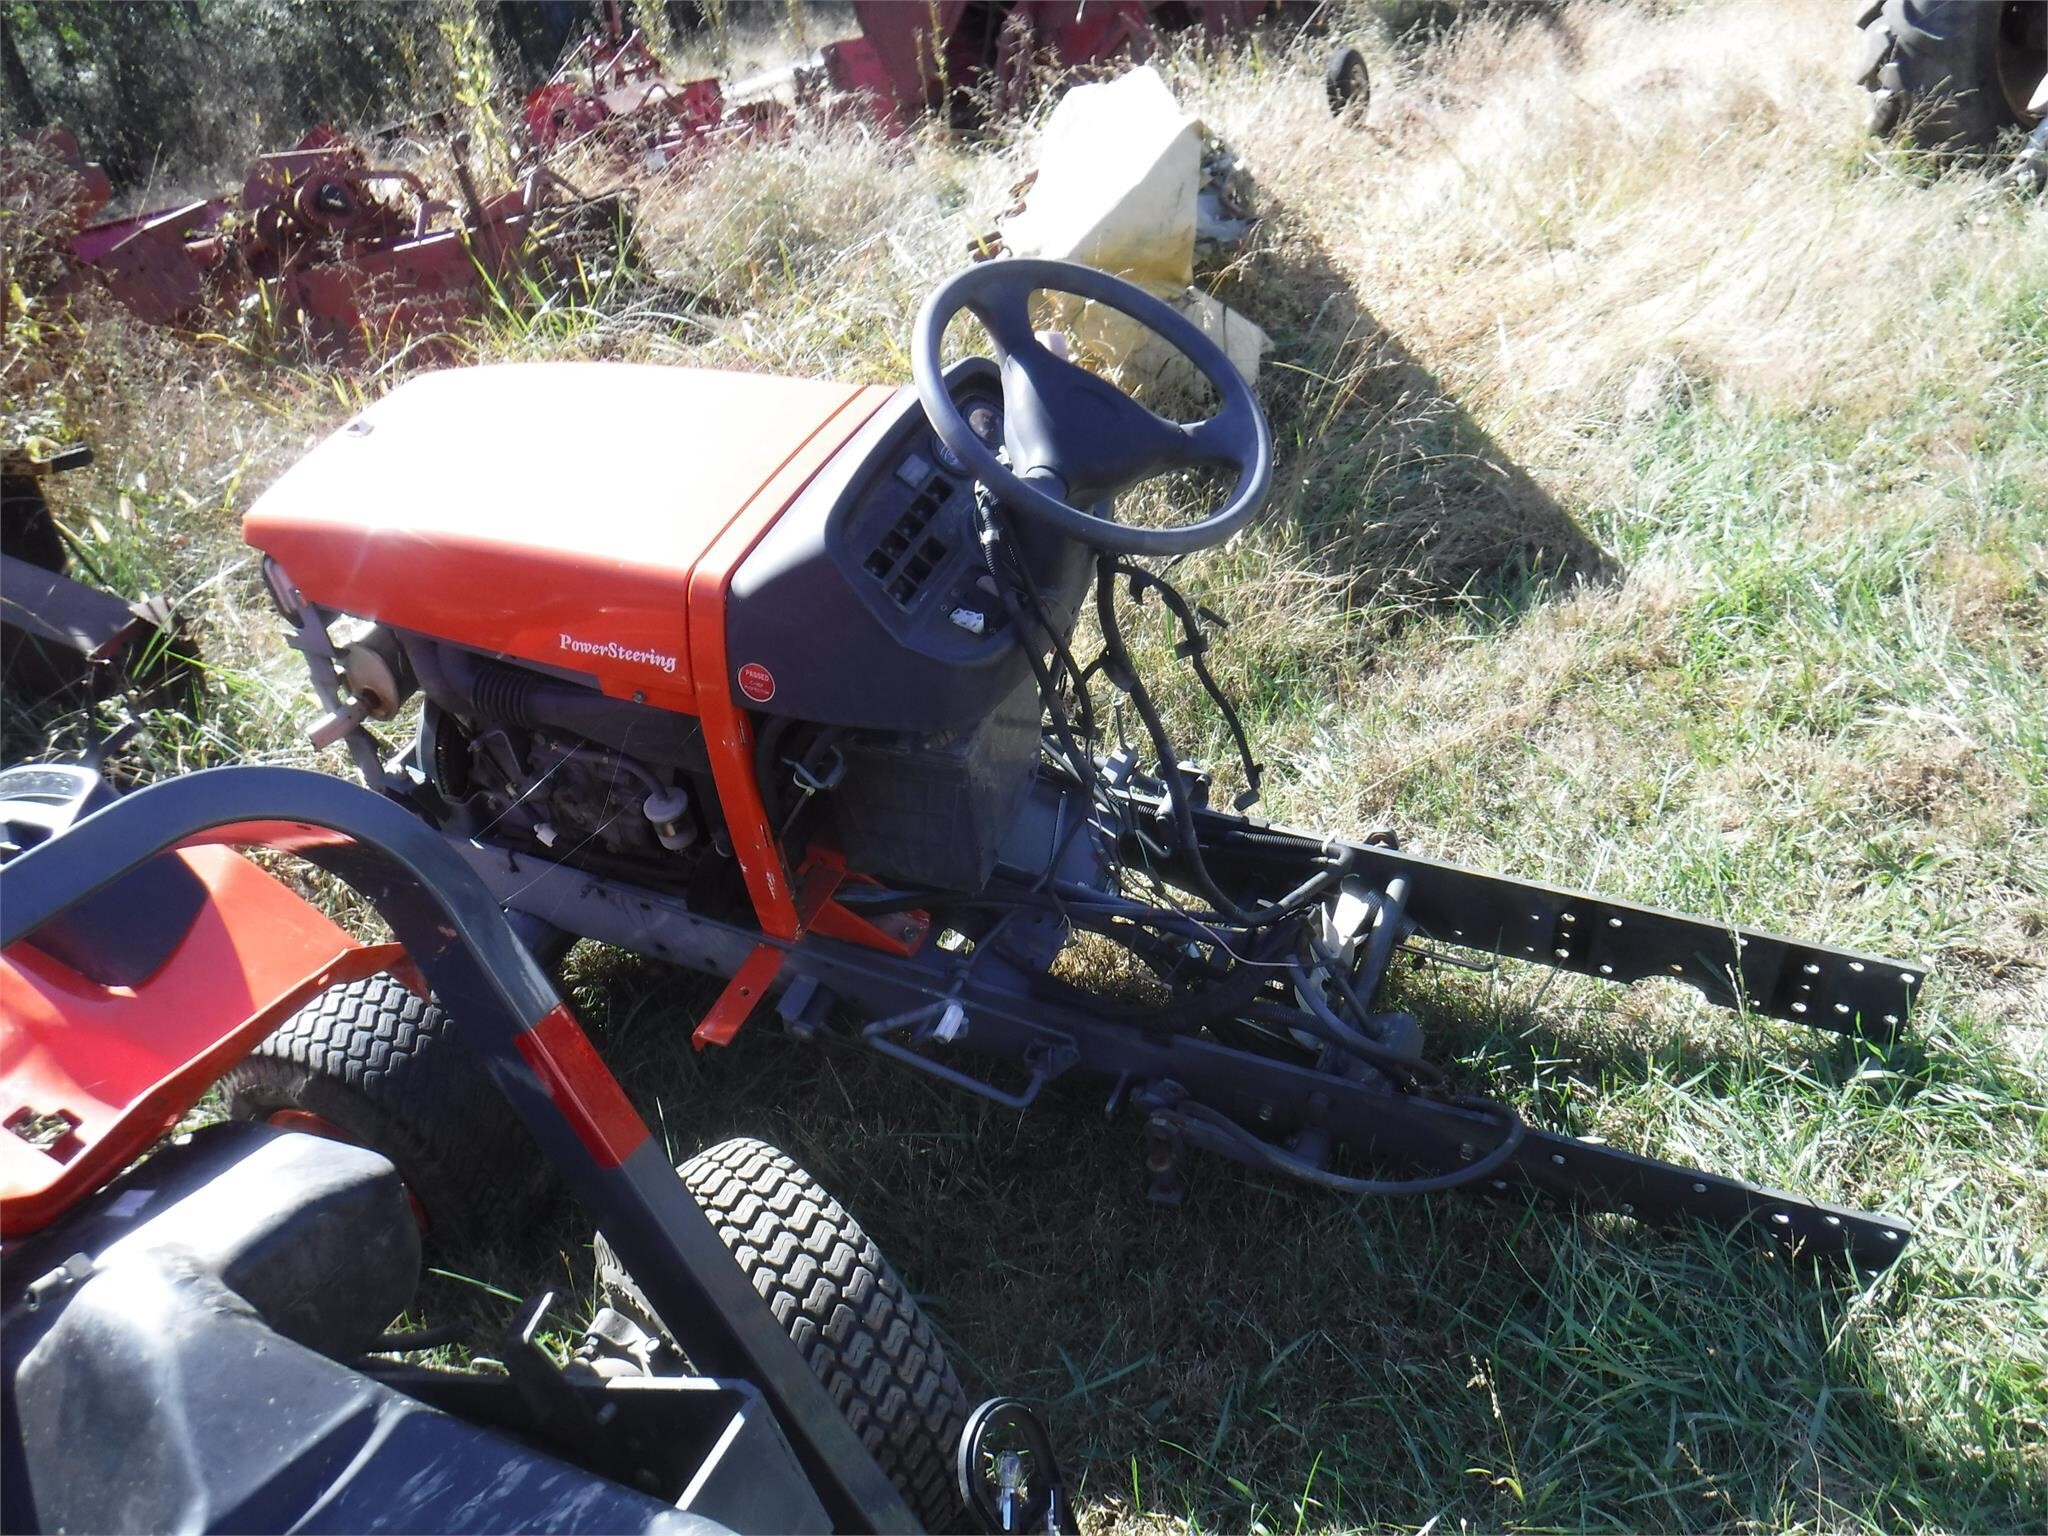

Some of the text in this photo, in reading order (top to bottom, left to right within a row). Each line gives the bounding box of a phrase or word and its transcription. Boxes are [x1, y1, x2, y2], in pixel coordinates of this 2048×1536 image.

[404, 285, 480, 308] HOLLAN
[559, 633, 677, 673] PowerSteering
[745, 669, 770, 681] PASSED
